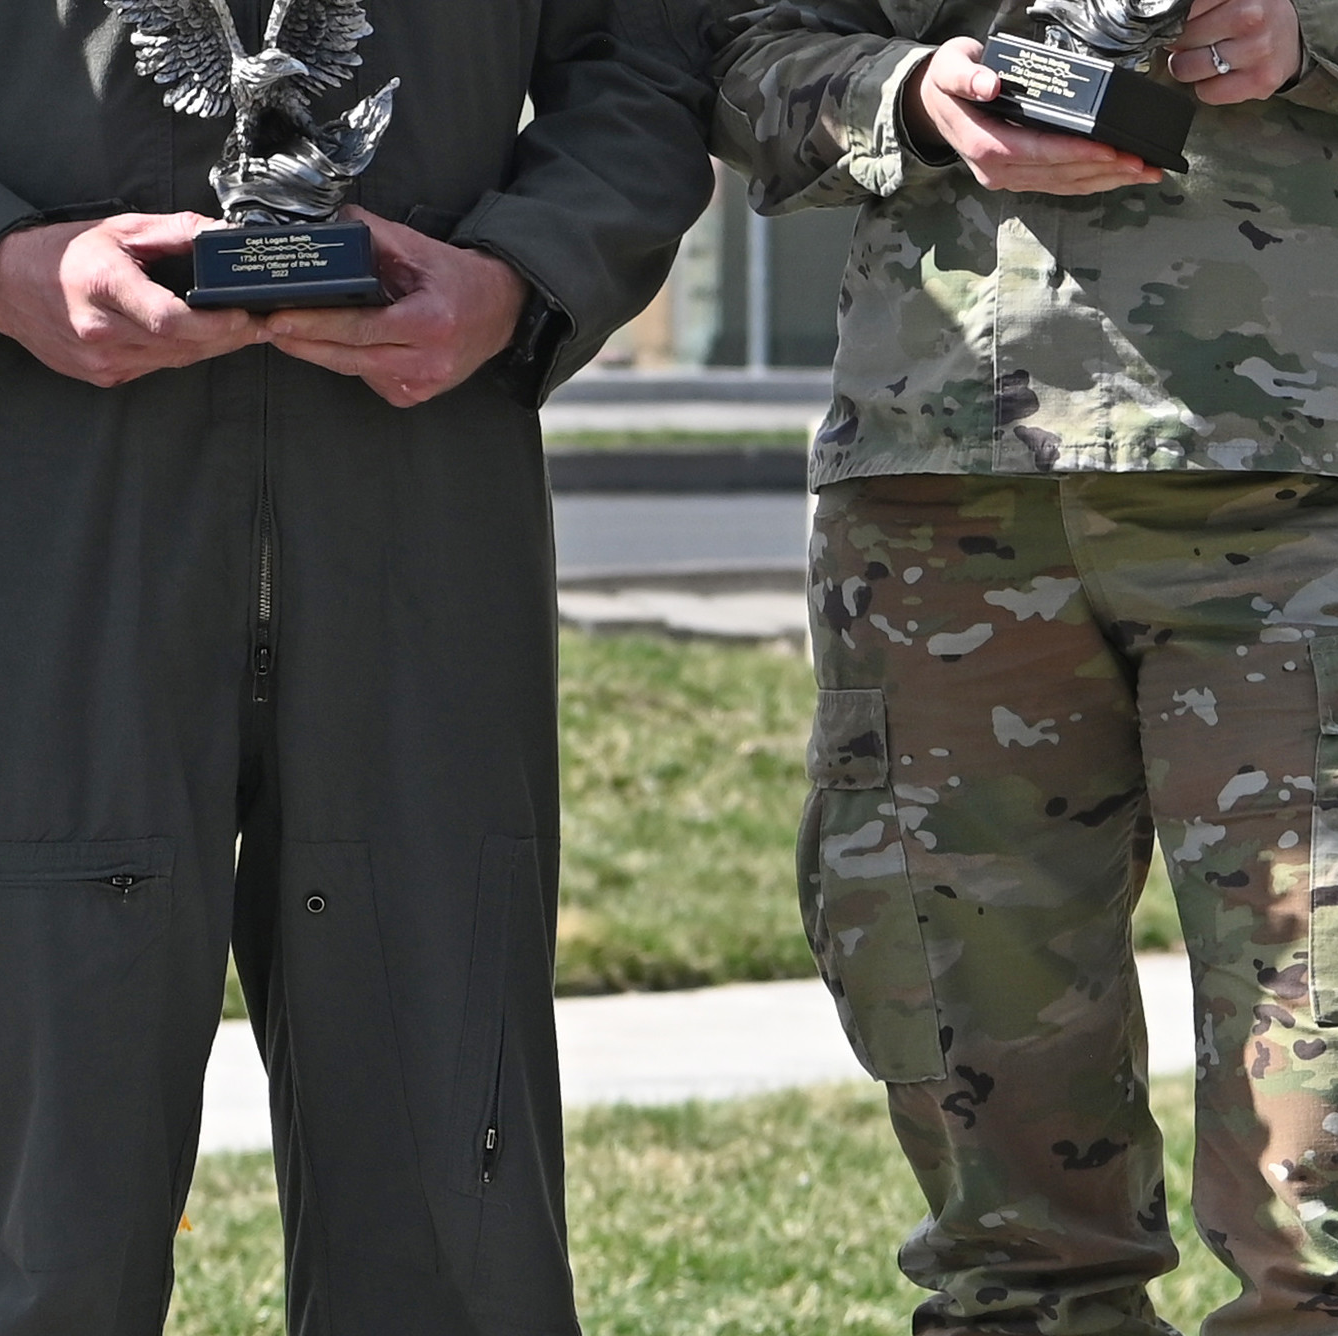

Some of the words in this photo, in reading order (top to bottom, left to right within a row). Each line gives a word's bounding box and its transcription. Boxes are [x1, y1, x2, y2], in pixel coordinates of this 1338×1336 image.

[265, 236, 288, 245] Logan
[240, 254, 257, 262] 173d
[258, 253, 296, 263] Operations
[298, 252, 319, 260] Group
[232, 263, 265, 273] Company
[266, 262, 290, 270] Officer
[312, 259, 327, 267] Year
